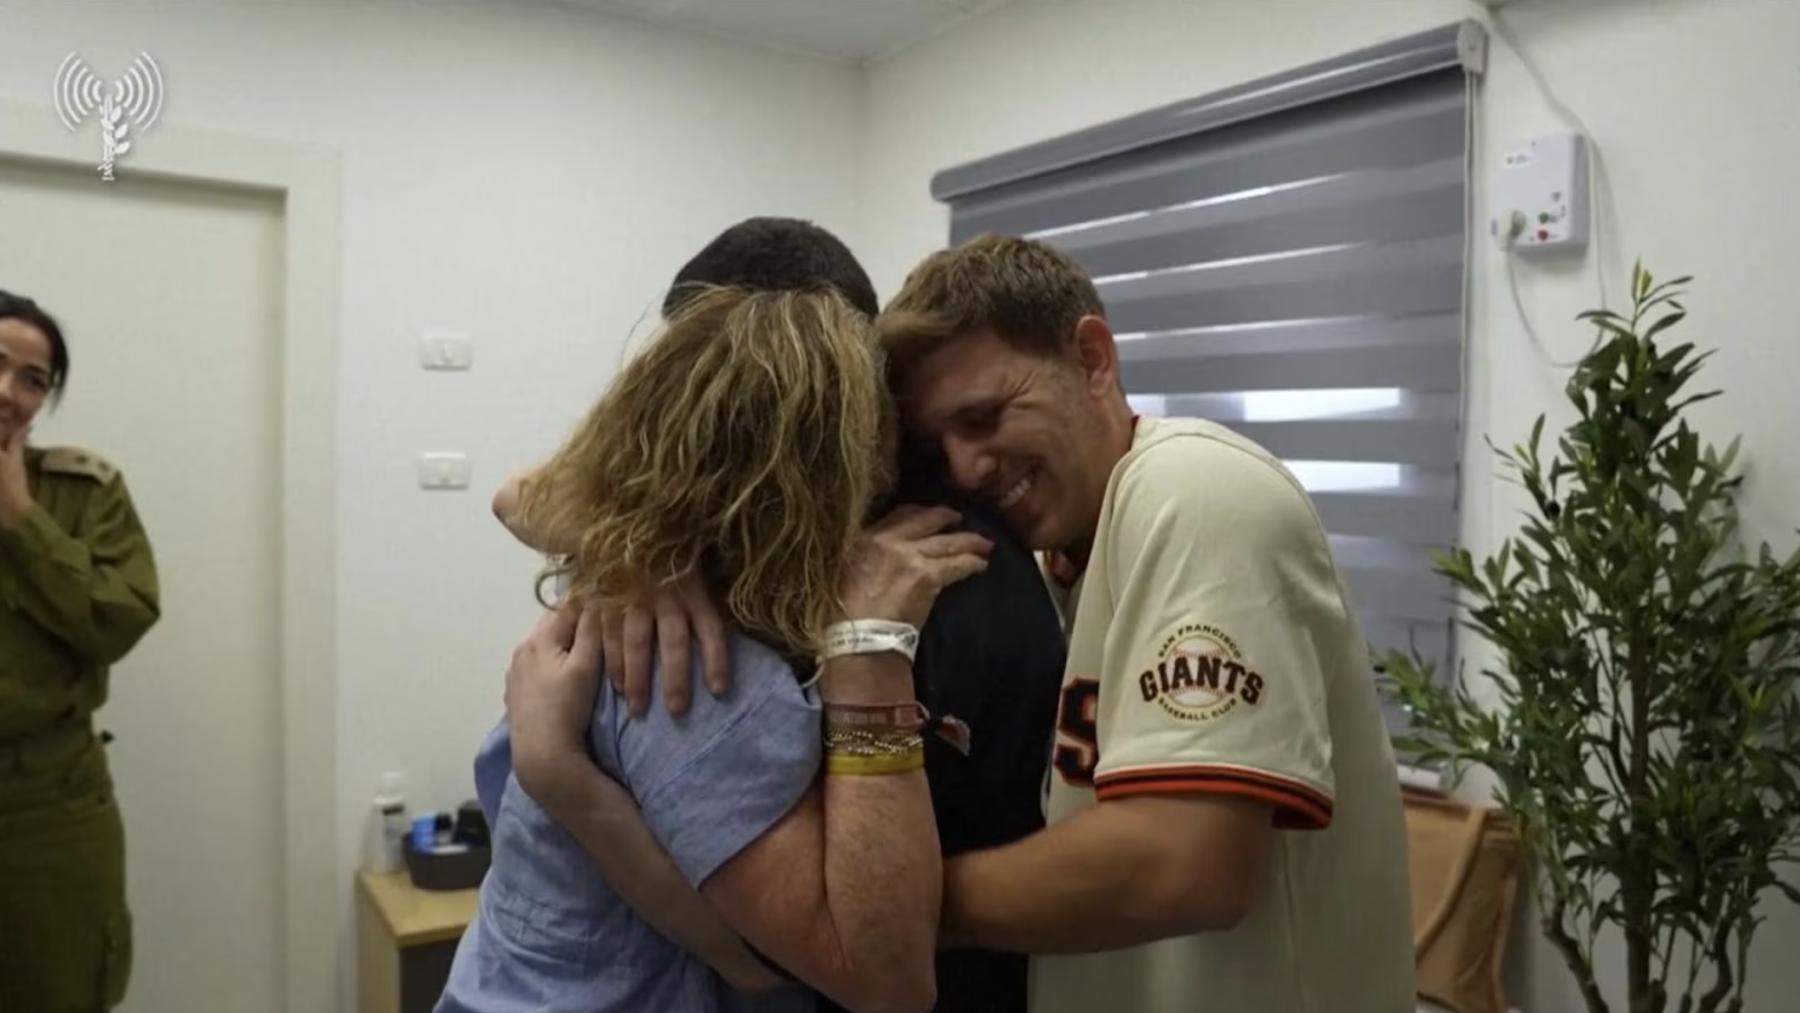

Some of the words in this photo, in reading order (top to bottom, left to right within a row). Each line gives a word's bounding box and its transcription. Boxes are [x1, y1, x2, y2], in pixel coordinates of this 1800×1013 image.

[1158, 635, 1176, 658] SAN
[1178, 624, 1242, 659] FRANCISCO
[1139, 655, 1264, 705] GIANTS
[1158, 697, 1208, 720] BASEBALL
[1211, 698, 1236, 718] CLUB
